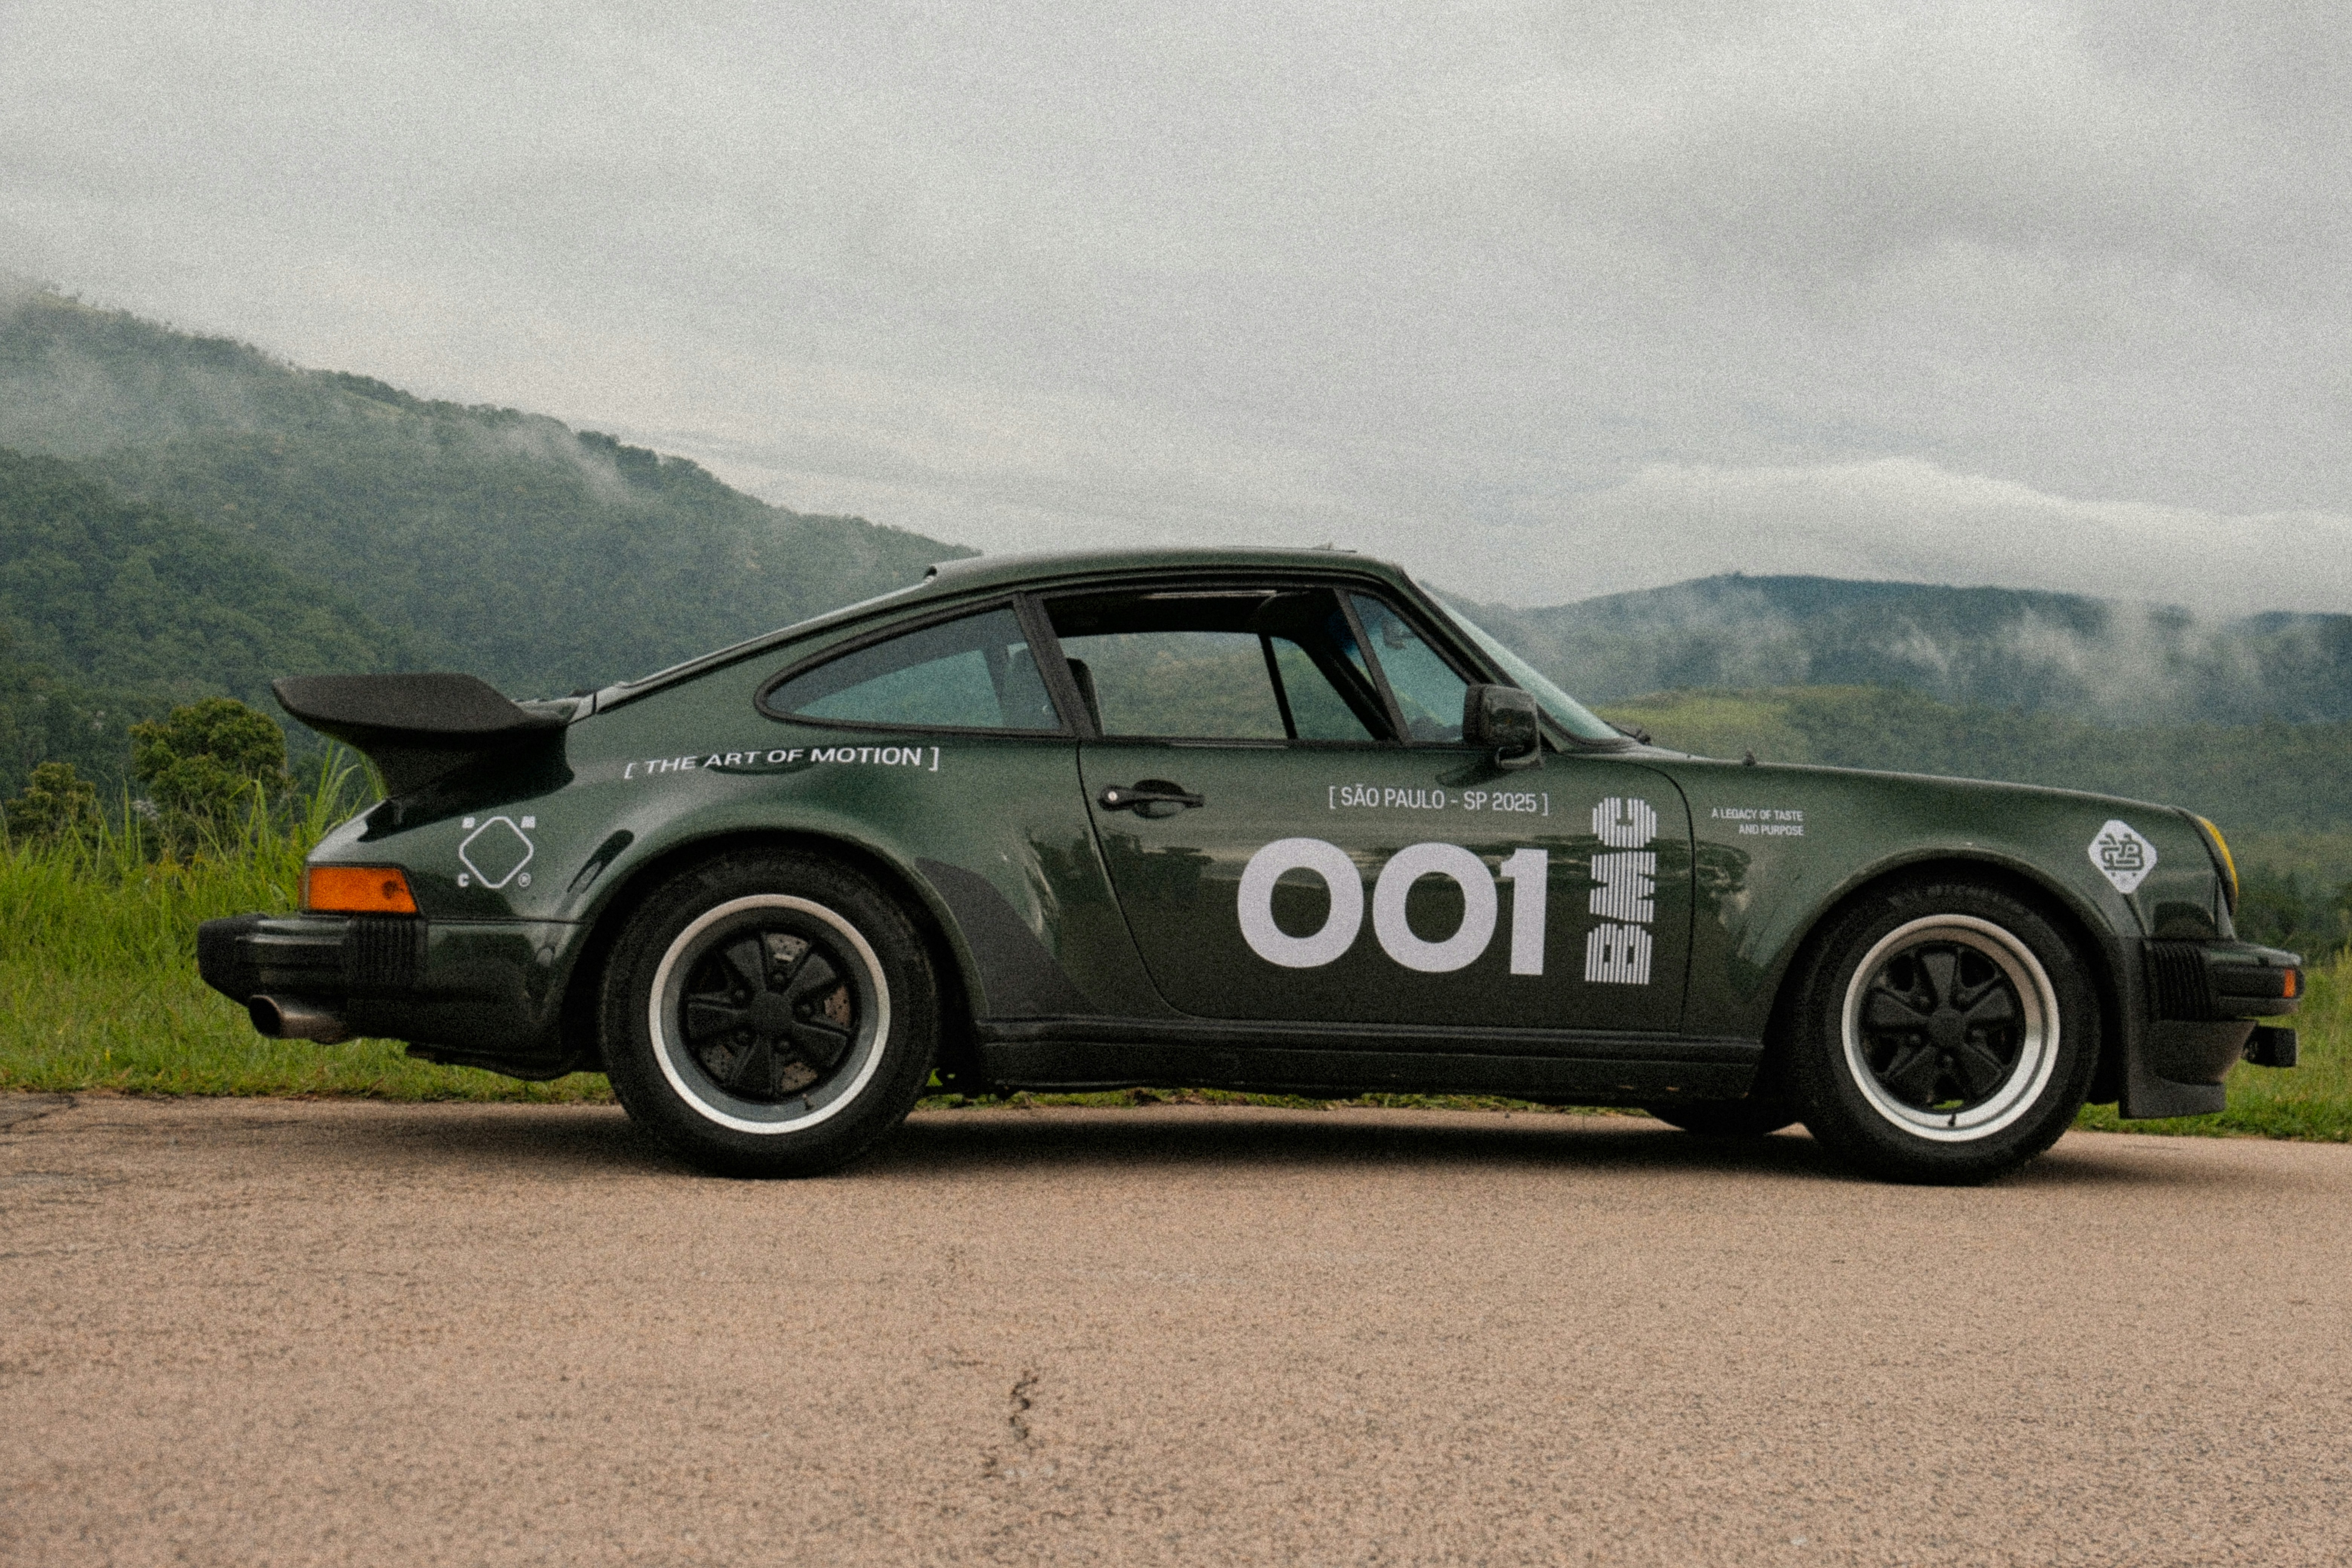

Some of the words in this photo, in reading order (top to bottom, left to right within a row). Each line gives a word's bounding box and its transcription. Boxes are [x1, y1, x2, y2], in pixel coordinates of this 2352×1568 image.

[645, 755, 698, 774] THE
[703, 751, 761, 768] ART
[767, 749, 804, 763] OF
[810, 747, 922, 766] MOTION
[1340, 783, 1380, 807] SÃO
[1384, 788, 1446, 810] PAULO
[1463, 790, 1488, 811] SP
[1492, 792, 1537, 813] 2025
[1711, 807, 1719, 818] A
[1759, 809, 1772, 820] OF
[1773, 810, 1804, 822] TASTE
[1738, 824, 1759, 835] AND
[1761, 824, 1805, 836] PURPOSE
[1237, 837, 1548, 975] 001
